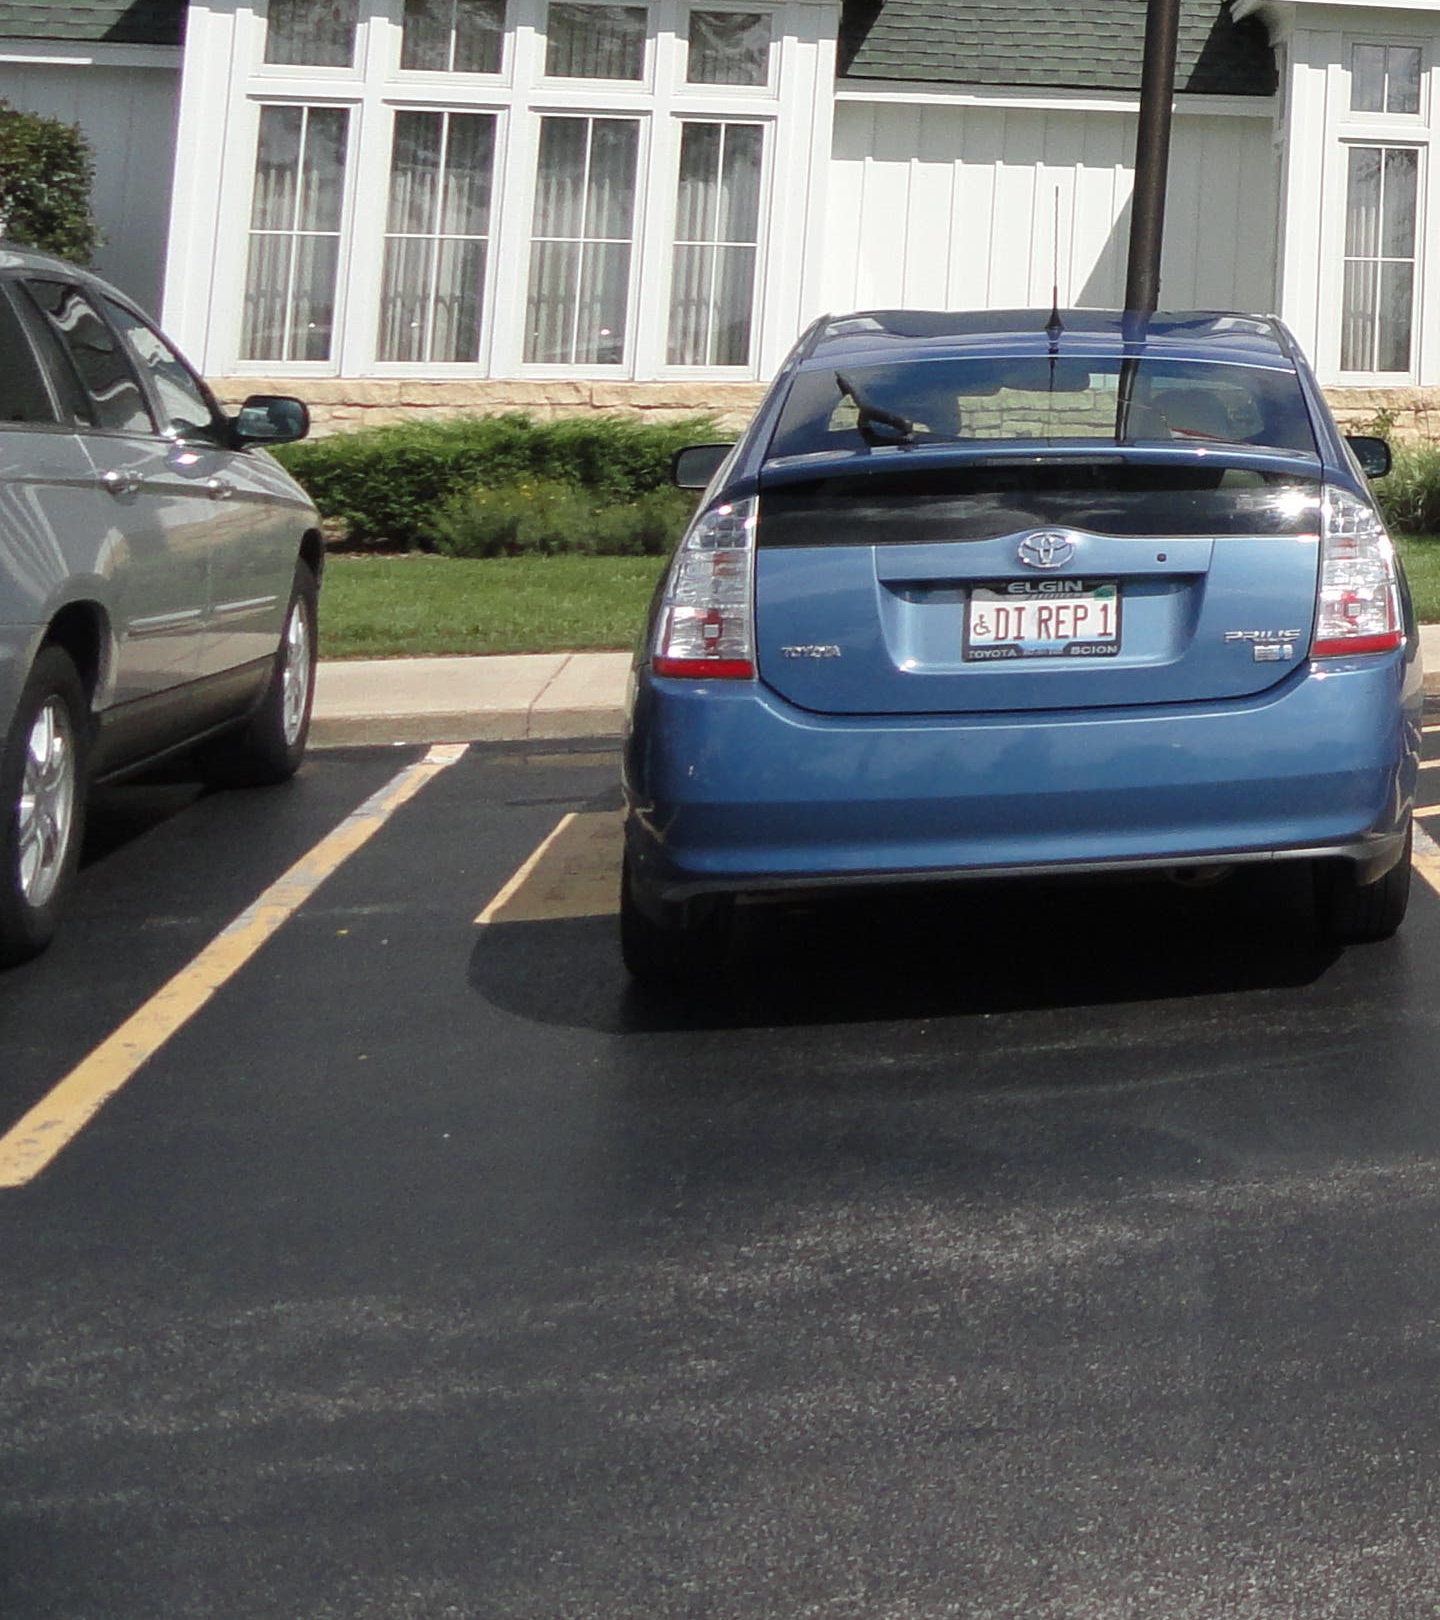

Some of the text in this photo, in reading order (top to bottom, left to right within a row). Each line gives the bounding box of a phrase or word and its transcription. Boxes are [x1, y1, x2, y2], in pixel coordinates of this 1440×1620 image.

[1007, 580, 1083, 594] ELGIN
[994, 603, 1114, 642] DI REP 1
[1224, 629, 1301, 642] PRIUS
[780, 644, 842, 658] TOYOTA
[968, 649, 1018, 660] TOYOTA
[1070, 645, 1118, 655] SCION
